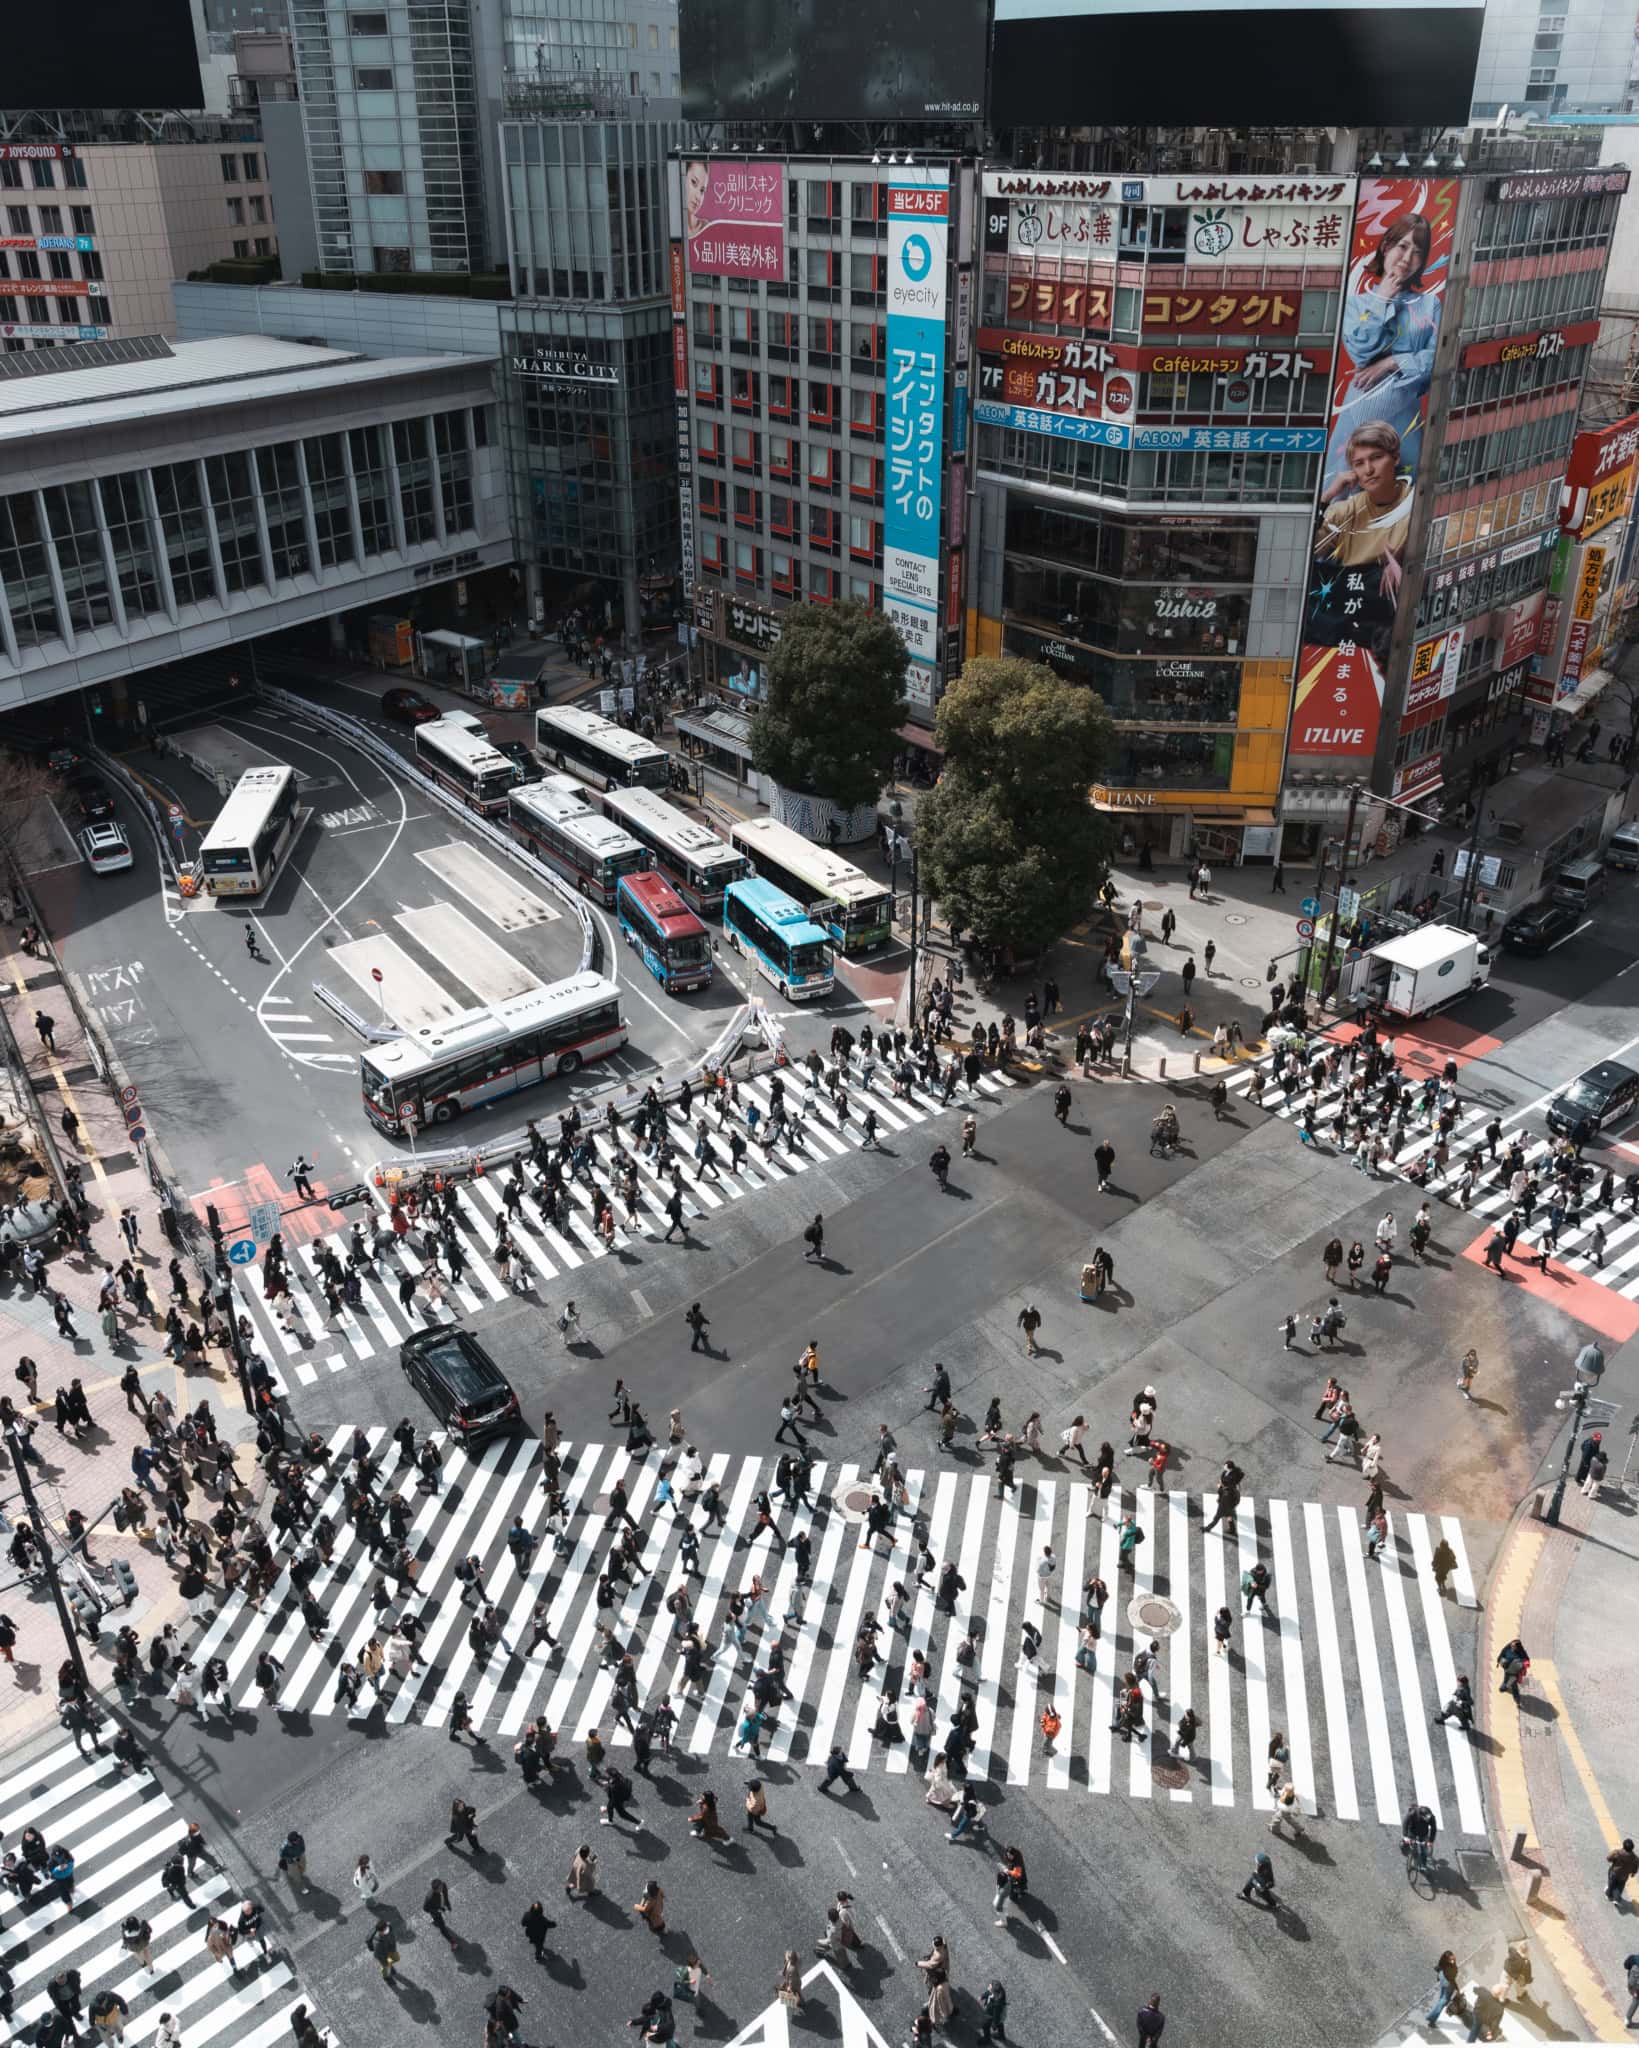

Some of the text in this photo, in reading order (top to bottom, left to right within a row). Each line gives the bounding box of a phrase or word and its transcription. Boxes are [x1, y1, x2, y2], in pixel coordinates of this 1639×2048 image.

[924, 103, 980, 113] www.hit-ad.co.jp
[9, 147, 56, 157] JOYSOUND
[727, 174, 778, 193] 品川スキン
[996, 177, 1112, 199] しゃぶしゃぶバイキング
[1176, 182, 1347, 204] しゃぶしゃぶバイキング
[727, 196, 772, 214] クリニック
[893, 192, 943, 212] 当ビル5F
[989, 214, 1007, 234] 9F
[1047, 211, 1113, 245] しゃぶ葉
[1242, 213, 1343, 249] しゃぶ葉
[39, 237, 74, 249] ADERANS
[701, 241, 779, 270] 品川美容外科
[893, 286, 938, 308] eyecity
[1009, 285, 1110, 320] プライス
[1143, 295, 1296, 326] コンタクト
[537, 348, 588, 361] SHIBUYA
[1536, 332, 1565, 356] ガスト
[513, 357, 619, 378] MARK CITY
[1064, 343, 1115, 372] ガスト
[1152, 352, 1314, 380] Caféレストラン ガスト
[982, 366, 1004, 388] 7F
[1008, 369, 1034, 388] Café
[1036, 371, 1097, 411] ガスト
[1109, 391, 1130, 405] ガスト
[978, 405, 1007, 420] AEON
[891, 348, 915, 514] アイシティ
[1013, 409, 1102, 438] 英会話イーオン
[916, 352, 936, 520] コンタクトの
[1107, 428, 1121, 443] 6F
[1140, 431, 1183, 447] AEON
[1194, 432, 1322, 449] 英会話イーオン
[1544, 527, 1560, 548] 4F
[895, 557, 927, 574] CONTACT
[889, 576, 932, 597] SPECIALISTS
[902, 570, 919, 583] LENS
[1155, 599, 1216, 618] Ushi8
[1512, 621, 1533, 646] アコム
[1332, 573, 1365, 717] 私が、始まる。
[1156, 668, 1204, 678] L'OCCITANE
[1413, 647, 1431, 679] 薬
[1408, 682, 1440, 706] サンドラッグ
[1488, 667, 1523, 700] LUSH
[1304, 727, 1365, 744] 17LIVE
